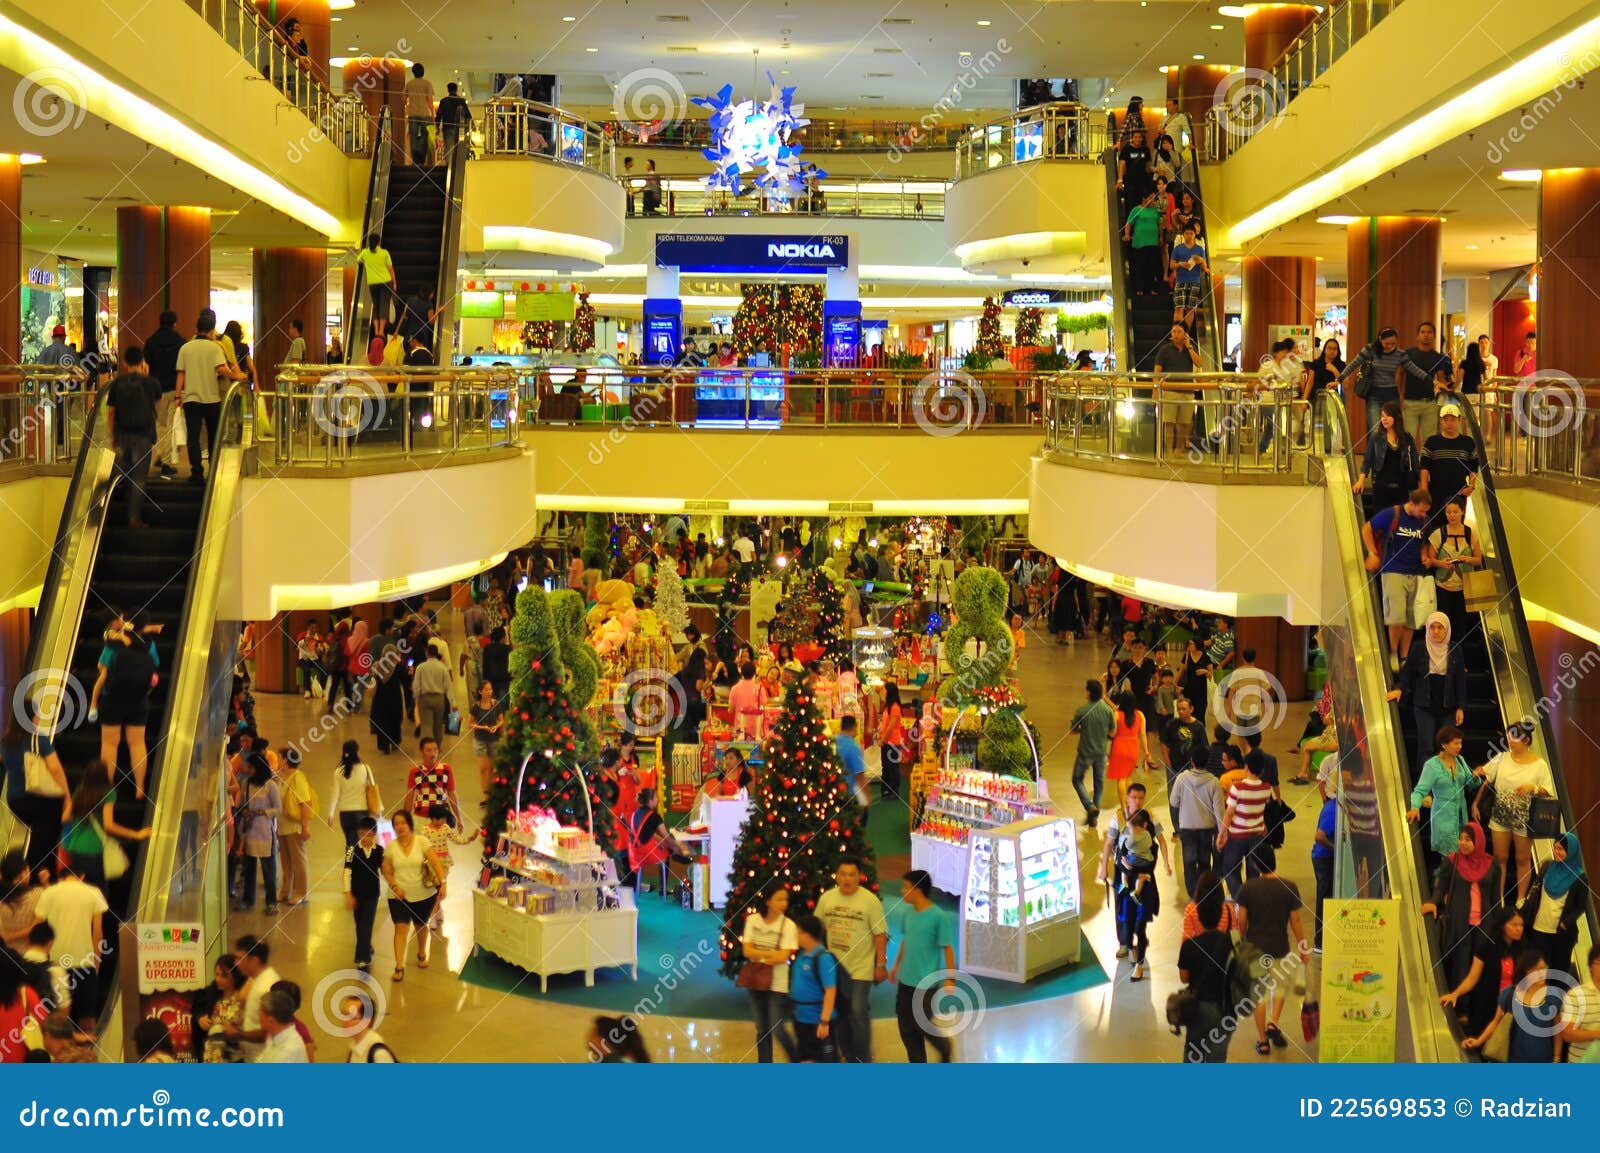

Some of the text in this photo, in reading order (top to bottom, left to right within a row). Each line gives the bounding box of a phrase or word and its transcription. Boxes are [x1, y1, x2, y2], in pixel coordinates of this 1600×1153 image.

[822, 236, 844, 245] FK-03
[768, 243, 836, 258] NOKIA
[145, 960, 196, 969] A SEASON TO
[145, 969, 196, 979] UPGRADE
